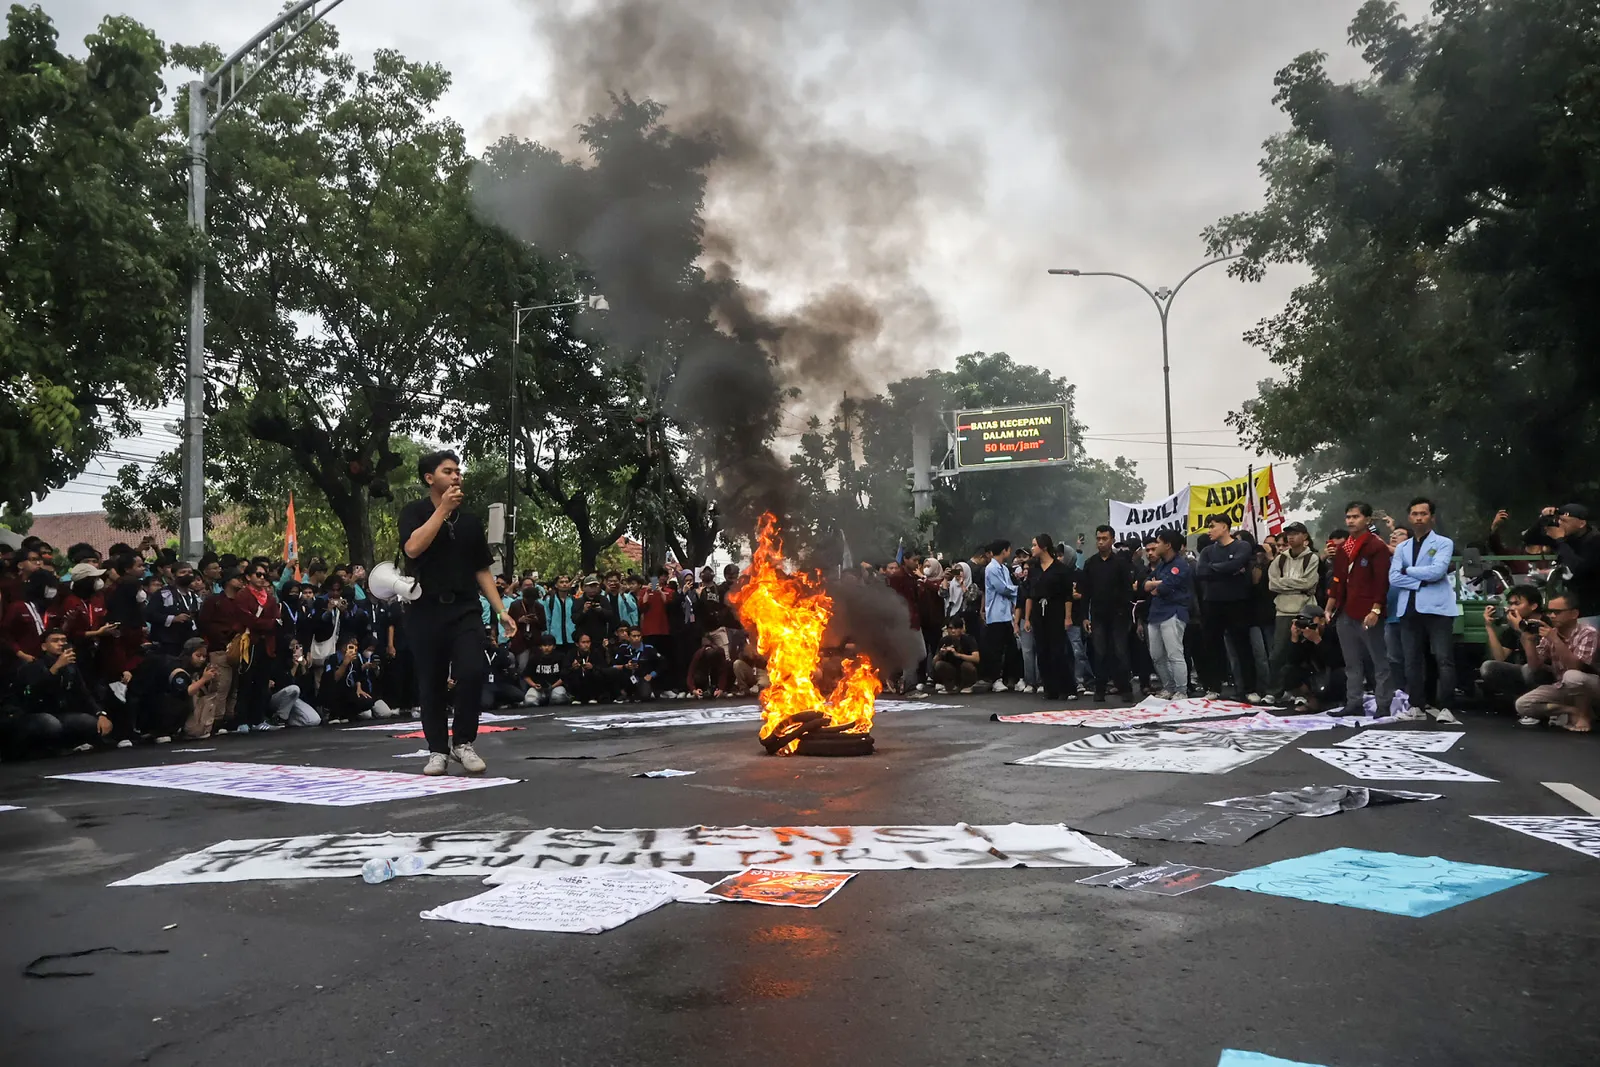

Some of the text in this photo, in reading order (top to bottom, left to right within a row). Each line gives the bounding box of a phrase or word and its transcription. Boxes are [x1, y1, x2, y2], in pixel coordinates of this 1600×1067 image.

[970, 416, 1052, 430] BATAS KECEPATAN
[983, 428, 1040, 440] DALAM KOTA
[984, 443, 998, 452] 50
[1126, 496, 1178, 525] ADILI
[427, 851, 695, 870] BUNUH
[737, 848, 928, 867] DIRI
